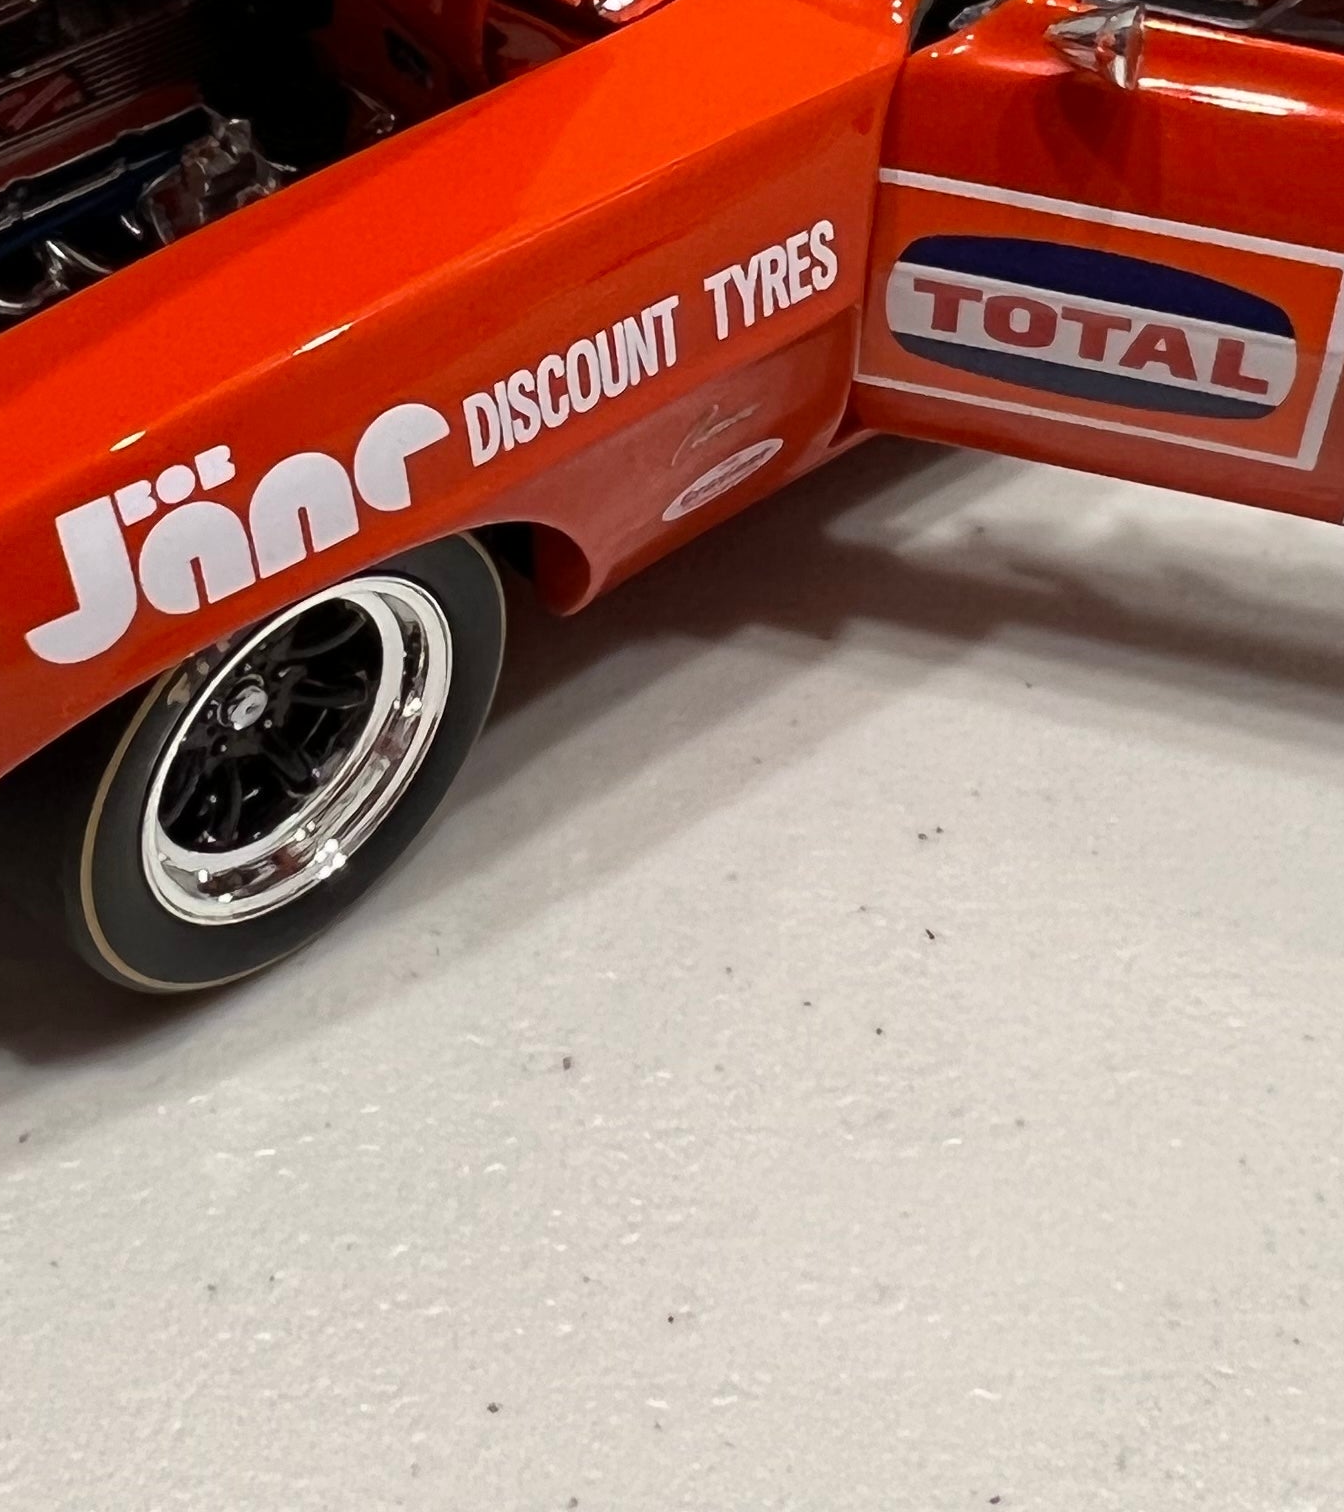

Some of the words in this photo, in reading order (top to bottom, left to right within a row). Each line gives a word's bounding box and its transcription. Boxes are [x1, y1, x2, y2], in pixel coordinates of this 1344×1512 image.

[462, 294, 680, 468] DISCOUNT
[703, 219, 839, 341] TYRES
[913, 277, 1269, 395] TOTAL
